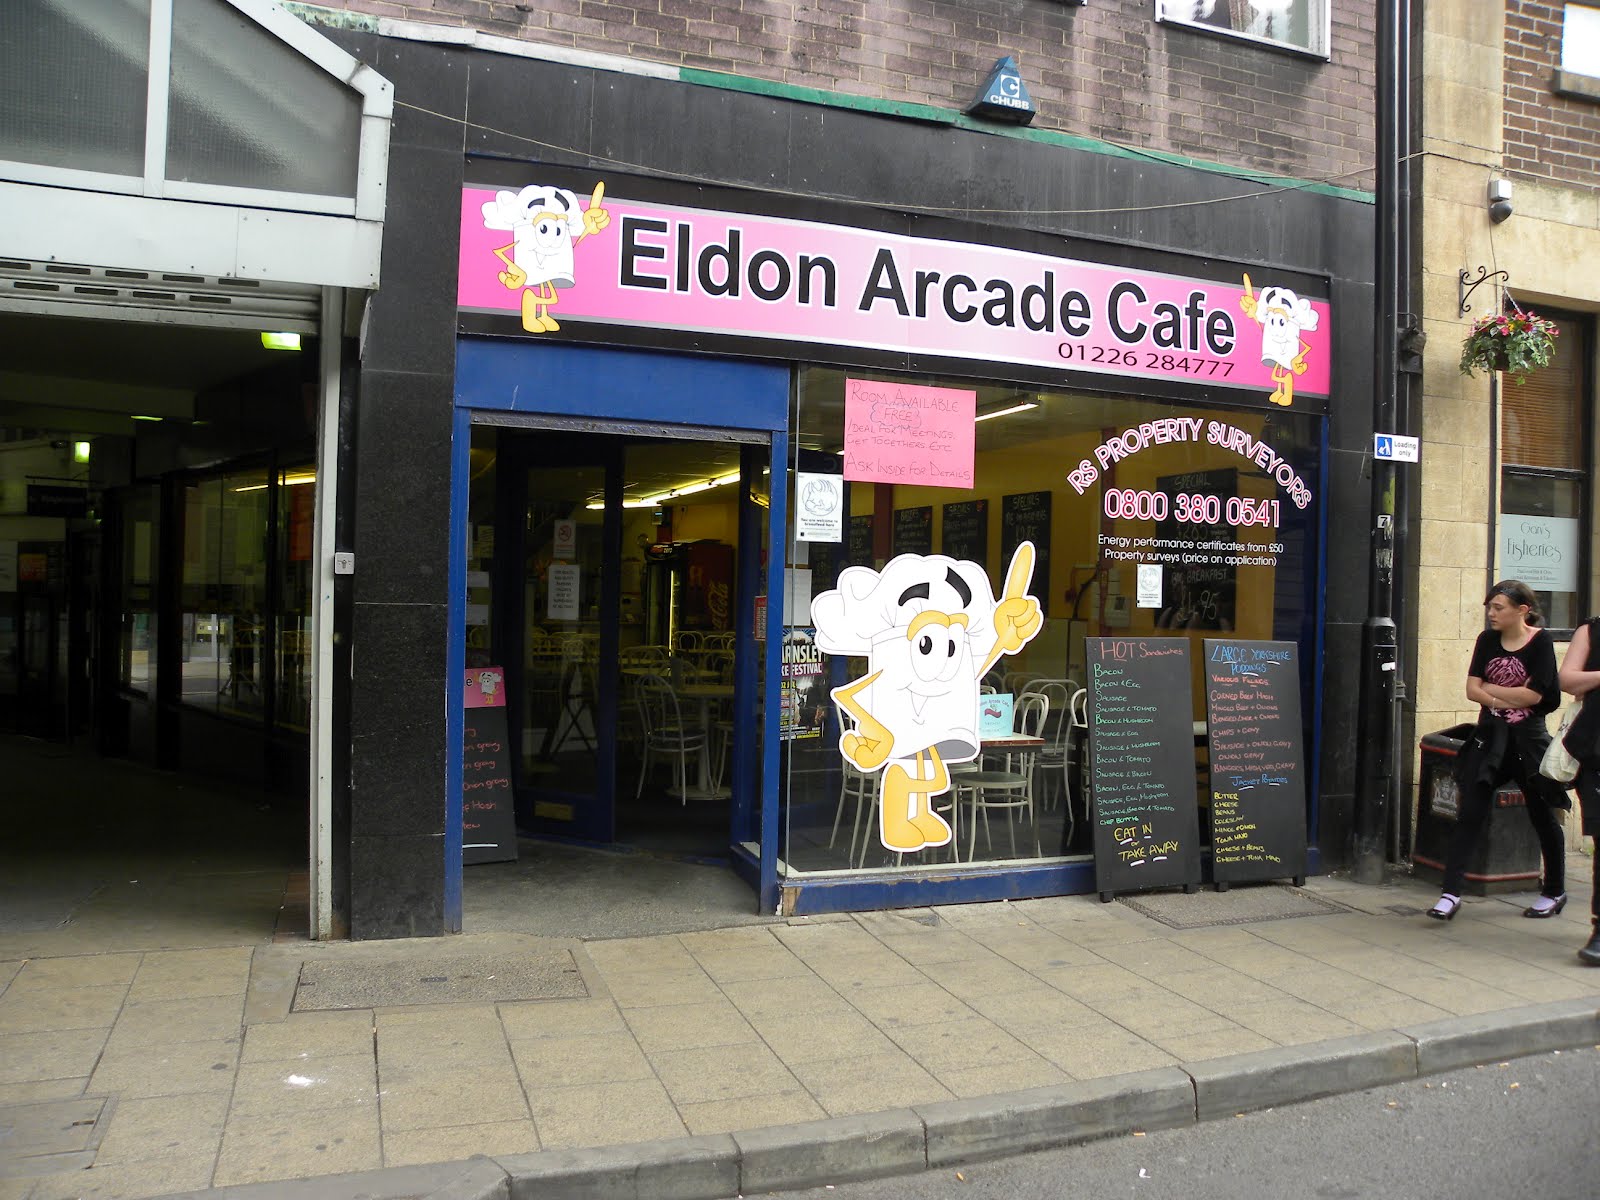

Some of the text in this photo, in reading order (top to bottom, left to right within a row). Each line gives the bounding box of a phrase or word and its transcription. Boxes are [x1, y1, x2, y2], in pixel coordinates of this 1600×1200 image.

[990, 94, 1030, 110] CHUBB
[620, 216, 1235, 355] Eldon Arcade Cafe
[1058, 342, 1235, 377] 01226 284777
[851, 382, 960, 412] ROOM AVAILABLE
[884, 408, 913, 421] FREE
[848, 419, 875, 433] IDEAL
[1394, 441, 1416, 450] Loading
[846, 452, 971, 480] ASK INSIDE FOR DETAILS
[1066, 417, 1312, 510] RS PROPERTY SURVEYORS
[1104, 488, 1280, 528] 0800 380 0541
[1098, 534, 1284, 554] Energy performance certificates from £50
[1508, 538, 1562, 563] Fisheries
[1104, 549, 1277, 567] Property surveys (price on application)
[1100, 641, 1136, 660] HOT
[1210, 644, 1291, 663] LARGE YORKSHIRE
[792, 663, 822, 676] FESTIVAL
[1230, 663, 1267, 675] PUDDINGS
[1212, 729, 1235, 738] CHIPS
[1229, 775, 1260, 787] JACKET
[1114, 822, 1152, 841] EAT IN
[1118, 840, 1179, 861] TAKE AWAY
